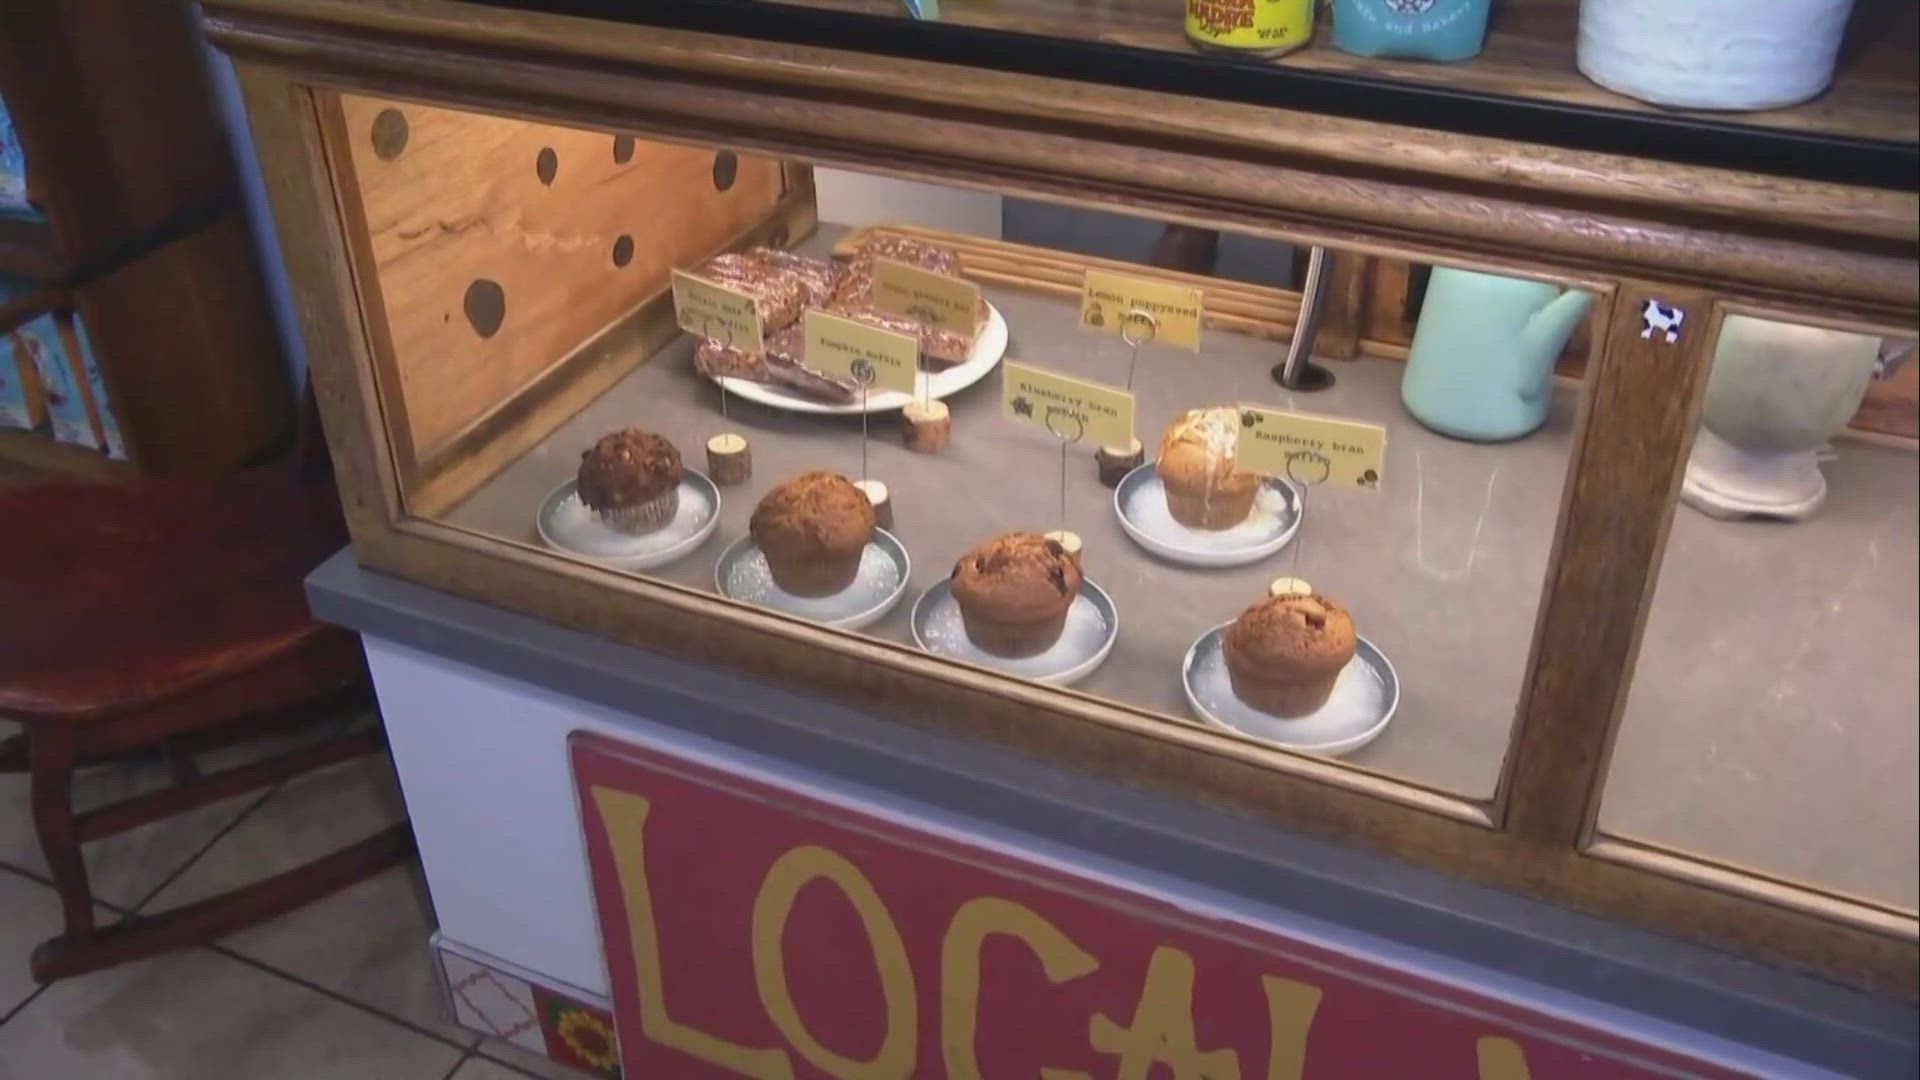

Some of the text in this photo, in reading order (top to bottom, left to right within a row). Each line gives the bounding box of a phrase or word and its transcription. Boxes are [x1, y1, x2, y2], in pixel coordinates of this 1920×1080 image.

[1088, 288, 1124, 305] Lemon
[820, 337, 902, 368] Pumpkin muffin
[1089, 401, 1118, 417] bran
[1255, 430, 1365, 455] Raspberry bran
